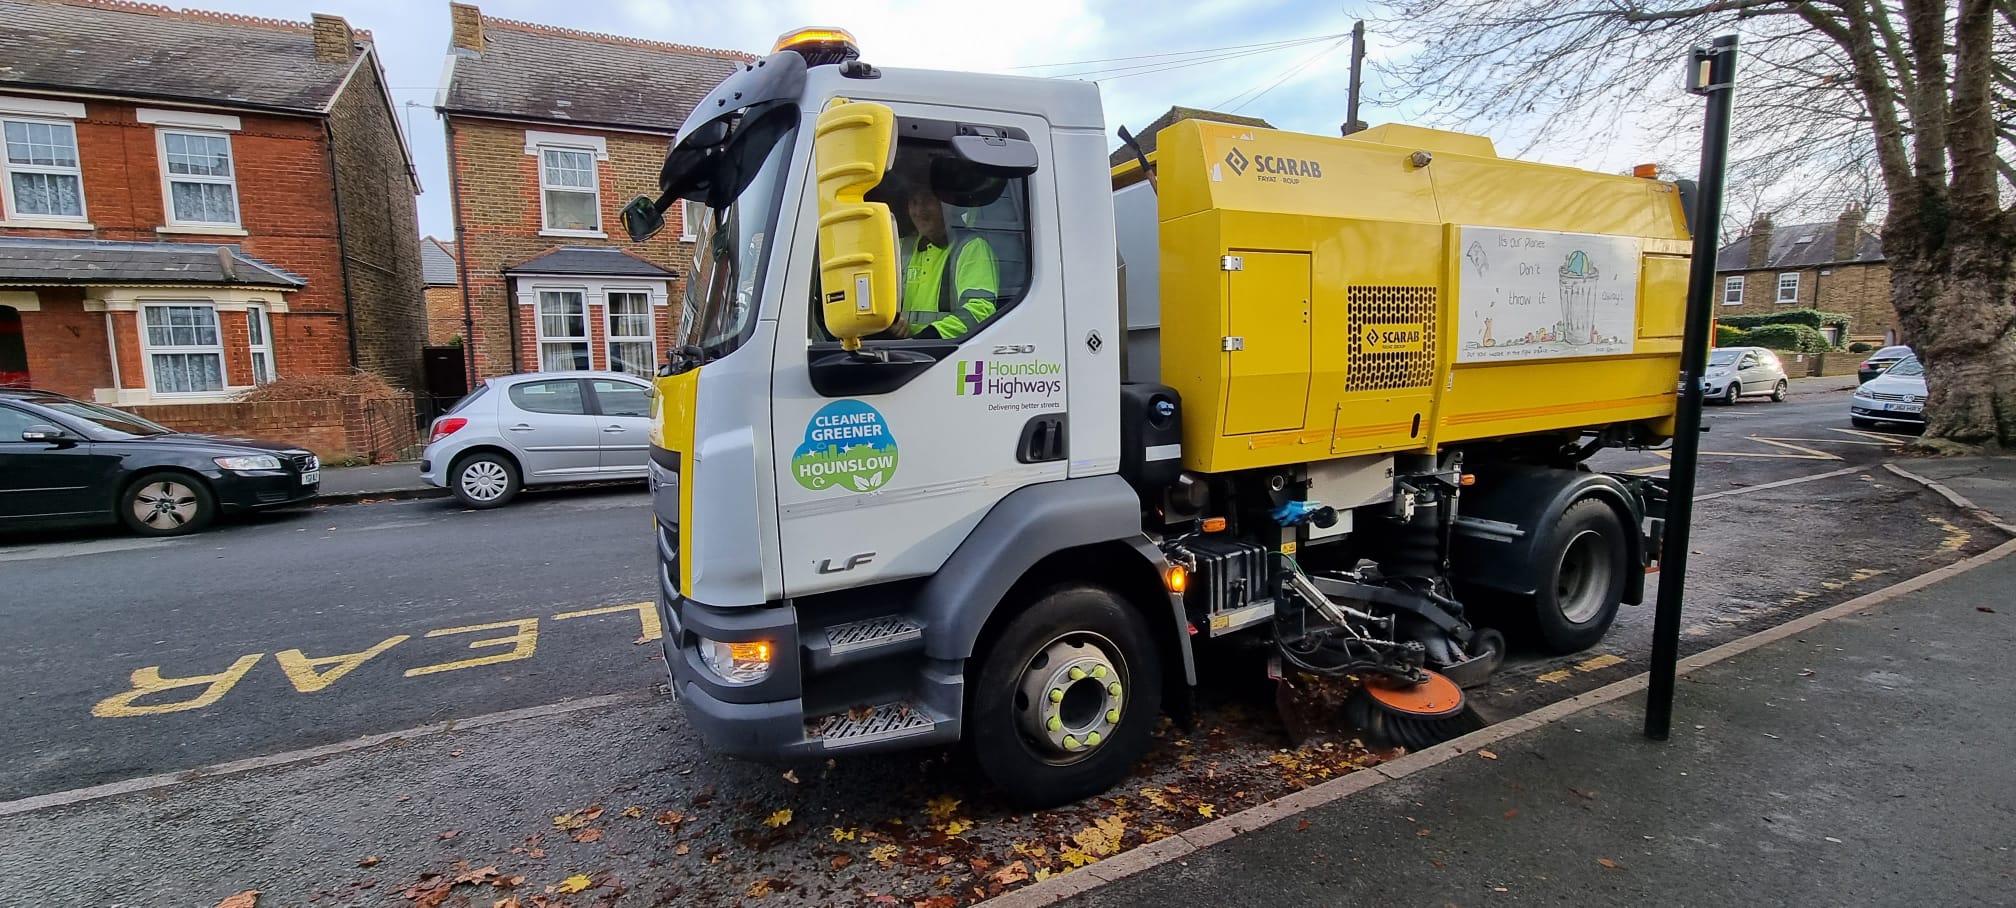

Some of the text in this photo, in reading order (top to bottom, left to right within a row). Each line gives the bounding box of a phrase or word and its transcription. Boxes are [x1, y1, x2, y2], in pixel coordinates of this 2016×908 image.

[1254, 154, 1322, 178] SCARAB
[1279, 177, 1300, 185] ROUP
[1508, 289, 1531, 306] throw
[1538, 291, 1547, 305] it
[1382, 331, 1420, 344] SCARAB
[992, 344, 1036, 355] 230
[988, 360, 1061, 376] Hounslow
[988, 377, 1061, 399] Highways
[988, 403, 1020, 411] Delivering
[1020, 402, 1039, 410] better
[815, 412, 876, 427] CLEANER
[811, 424, 883, 441] GREENER
[799, 456, 894, 477] HOUNSLOW
[815, 552, 876, 574] LF
[92, 602, 662, 718] LEAR
